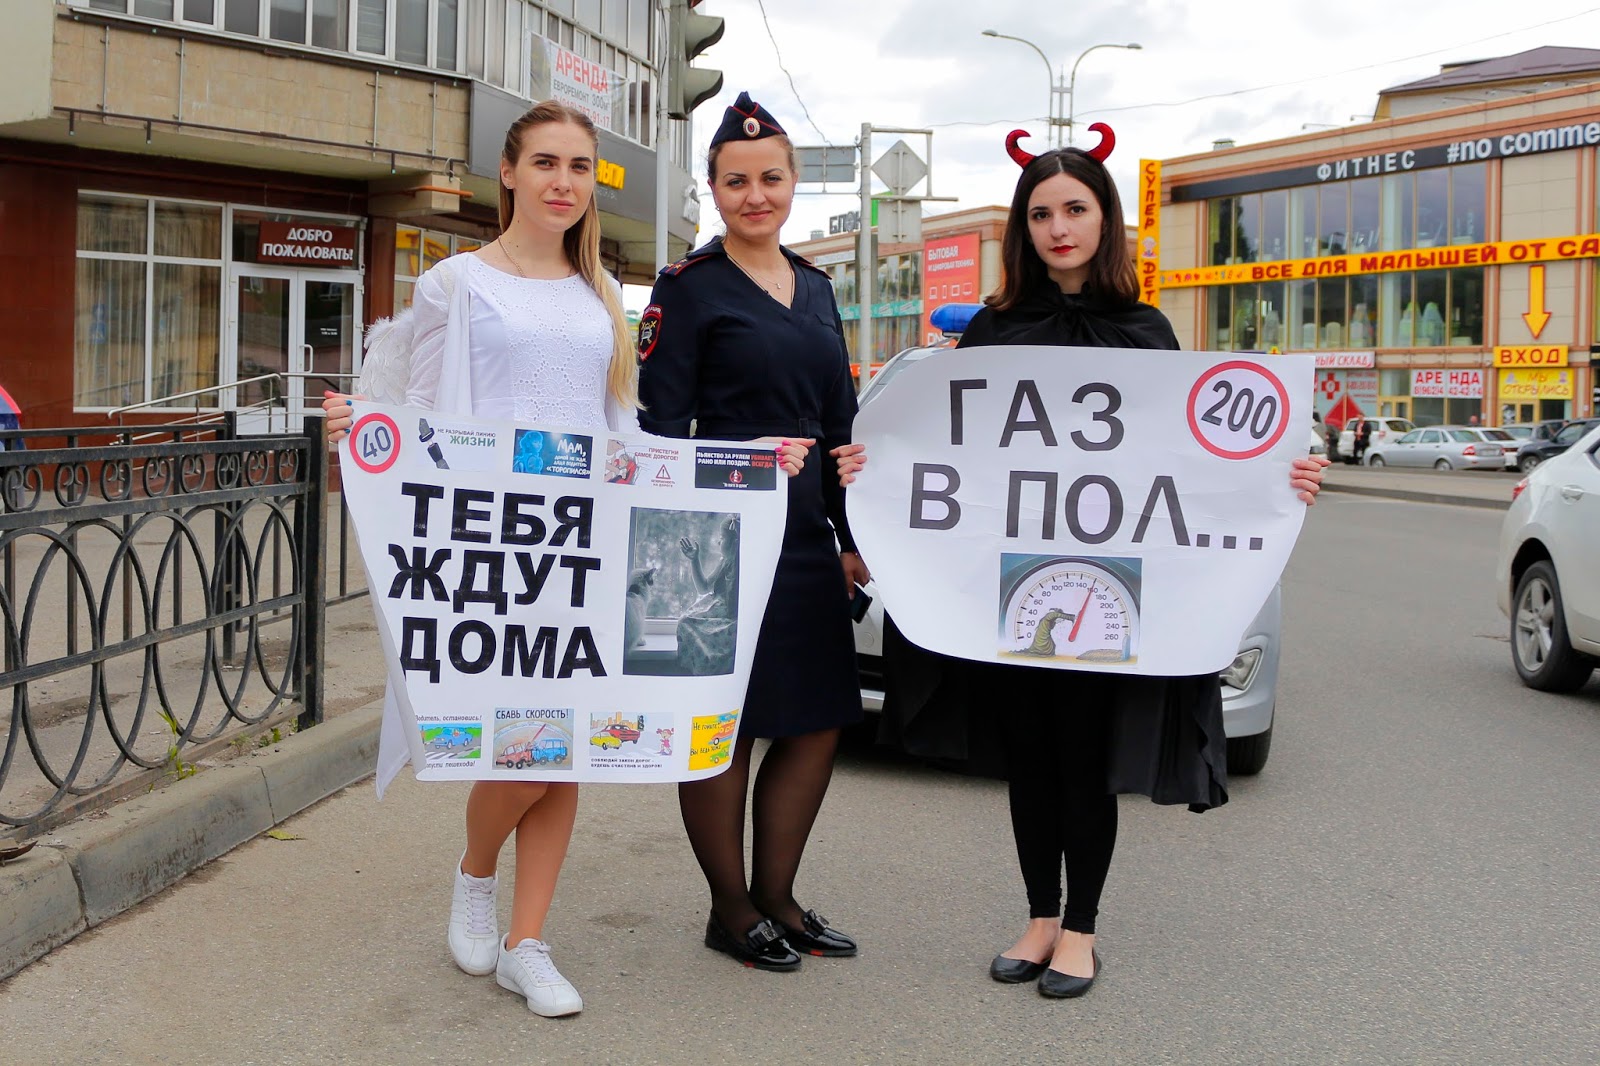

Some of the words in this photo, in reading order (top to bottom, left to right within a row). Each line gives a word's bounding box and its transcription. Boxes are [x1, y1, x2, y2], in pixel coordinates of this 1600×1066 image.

[556, 48, 608, 94] АРЕНДА
[553, 78, 589, 104] ЕВРОРЕМОНТ
[1317, 150, 1416, 181] ФИТНЕС
[1447, 138, 1493, 163] #no
[1500, 121, 1600, 155] comme
[1144, 162, 1156, 230] СУПЕР
[286, 228, 333, 242] ДОБРО
[262, 243, 354, 260] ПОЖАЛОВАТЬ!
[928, 245, 959, 261] БЫТОВАЯ
[955, 258, 974, 268] ТЕХНИКА
[1251, 264, 1293, 280] ВСЕ
[1302, 259, 1348, 277] ДЛЯ
[1360, 245, 1497, 271] МАЛЫШЕЙ
[1509, 242, 1546, 260] ОТ
[1557, 238, 1600, 257] СА
[1501, 348, 1559, 364] ВХОД
[1528, 372, 1548, 382] МЫ
[949, 378, 1124, 452] ГАЗ
[1201, 380, 1277, 440] 200
[363, 426, 391, 458] 40
[445, 428, 475, 436] РАЗРЫВАЙ
[450, 435, 496, 447] ЖИЗНИ
[648, 447, 679, 455] ПРИСТЕГНИ
[726, 459, 751, 467] ПОЗДНО.
[401, 482, 595, 549] ТЕБЯ
[909, 463, 961, 531] В
[1006, 470, 1263, 551] ПОЛ...
[388, 543, 602, 616] ЖДУТ
[399, 616, 608, 684] ДОМА
[496, 709, 521, 719] СБАВЬ
[525, 708, 569, 719] СКОРОСТЬ!
